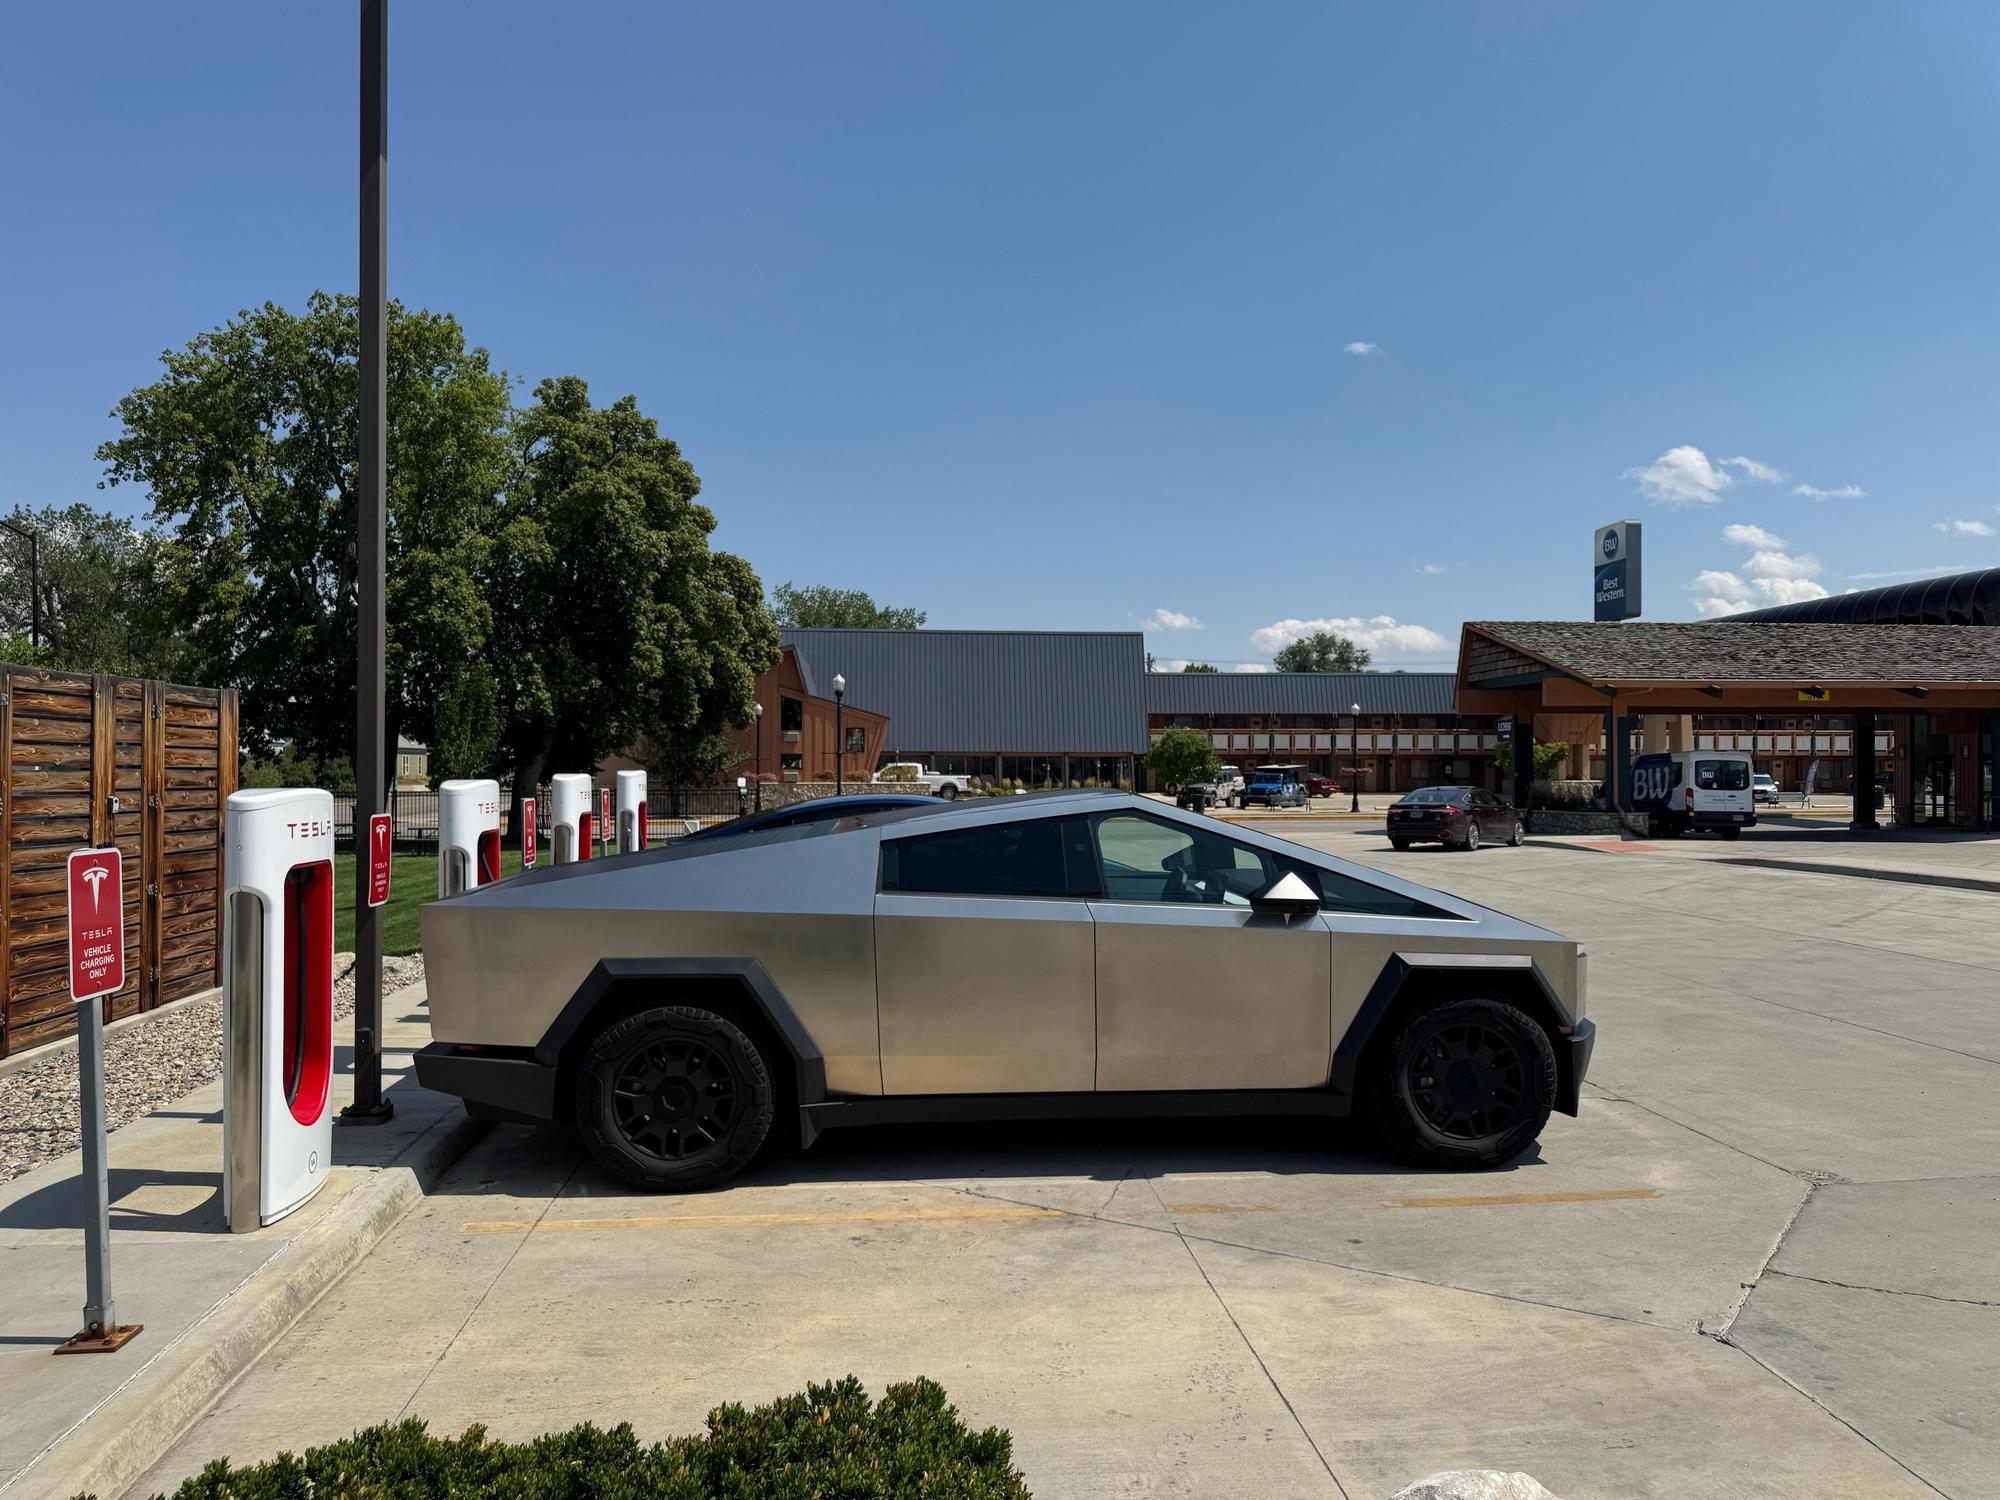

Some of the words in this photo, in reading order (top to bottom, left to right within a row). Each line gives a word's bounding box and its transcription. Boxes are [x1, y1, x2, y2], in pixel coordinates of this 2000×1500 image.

[1604, 537, 1617, 552] BW
[1603, 577, 1618, 590] Best
[1596, 588, 1625, 603] Western
[1498, 722, 1512, 731] LOBB
[1702, 771, 1714, 779] BW
[1633, 766, 1670, 800] BW
[287, 820, 331, 839] TESLA
[82, 927, 113, 940] TESLA
[83, 943, 112, 957] VEHICLE
[80, 954, 115, 970] CHARGING
[89, 966, 107, 979] ONLY
